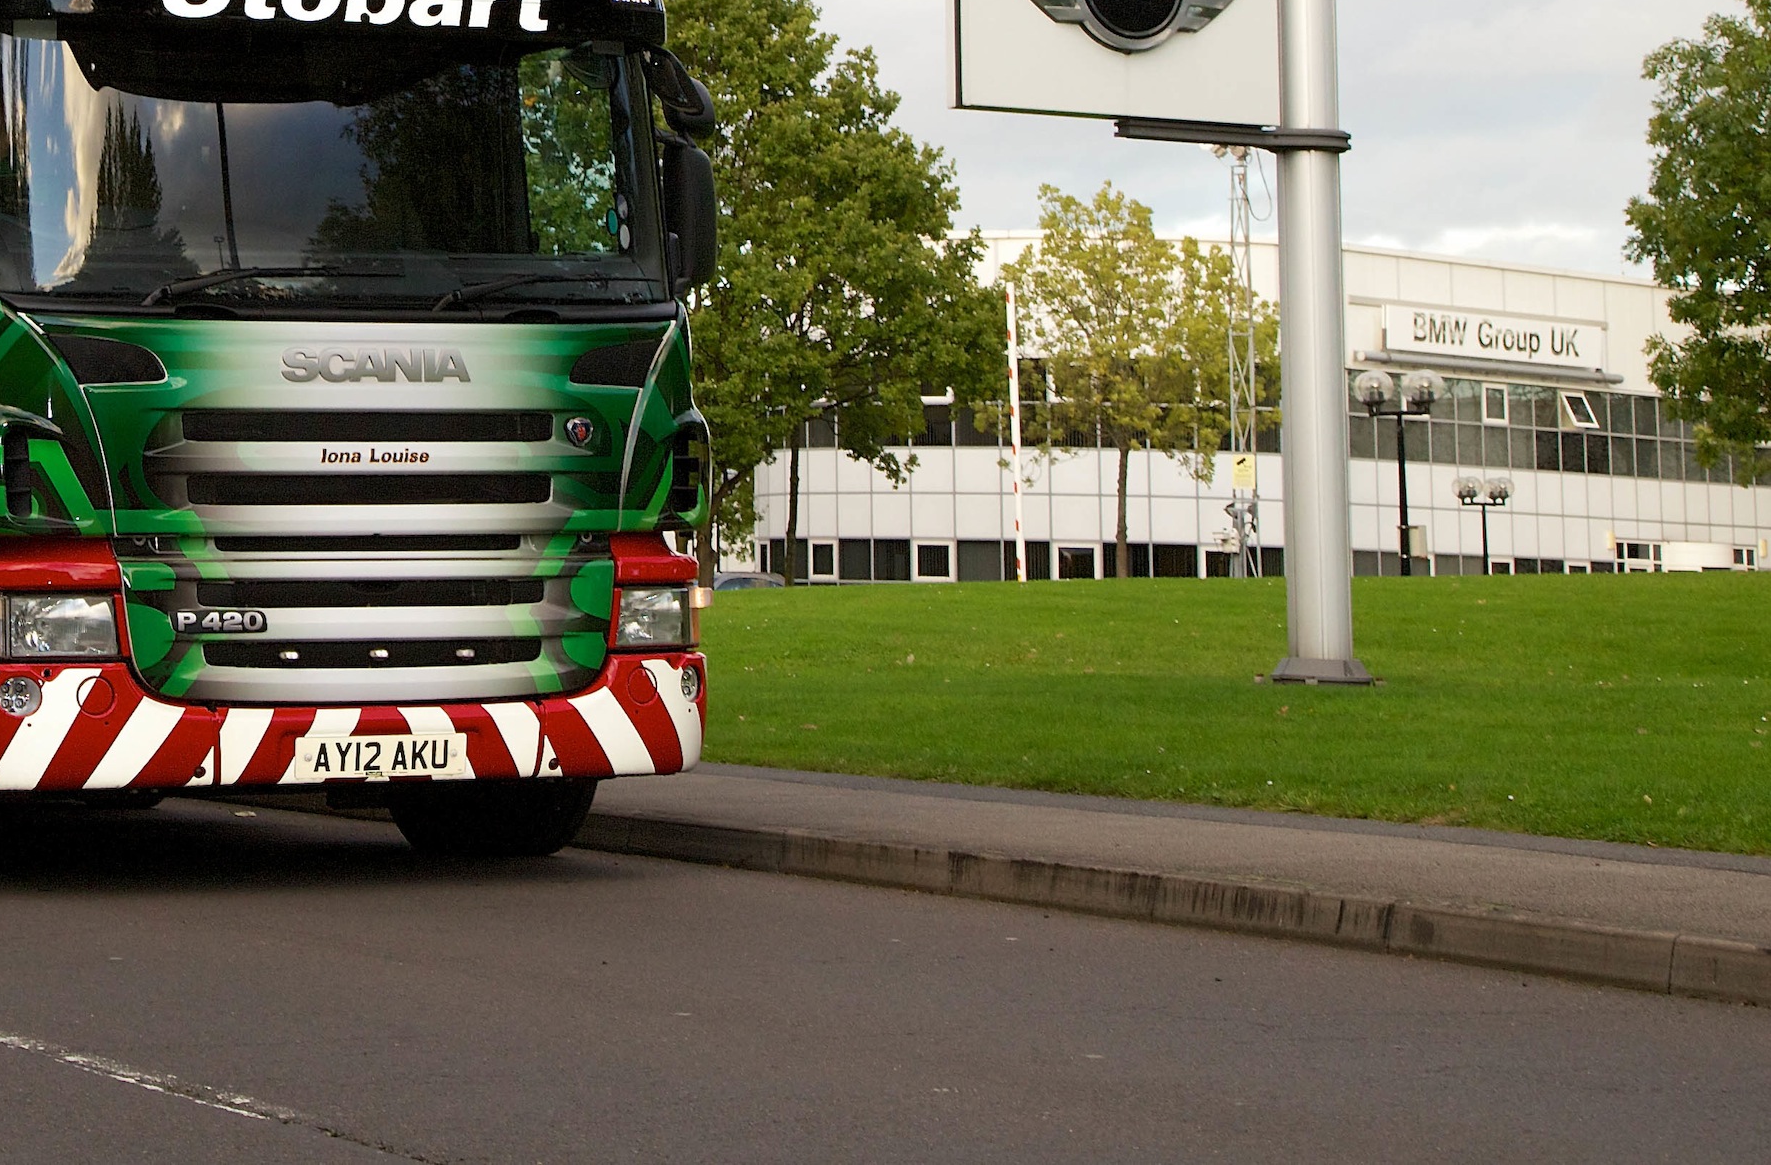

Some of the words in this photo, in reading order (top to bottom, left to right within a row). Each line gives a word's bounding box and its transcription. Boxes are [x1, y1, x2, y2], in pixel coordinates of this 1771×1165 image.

[1413, 312, 1467, 346] BMW
[1478, 318, 1540, 358] Group
[1550, 326, 1580, 358] UK
[281, 346, 471, 382] SCANIA
[321, 448, 362, 464] Iona
[369, 448, 430, 464] Louise
[177, 612, 197, 632] P
[201, 611, 264, 632] 420
[314, 741, 382, 773] AY12
[391, 739, 450, 771] AKU
